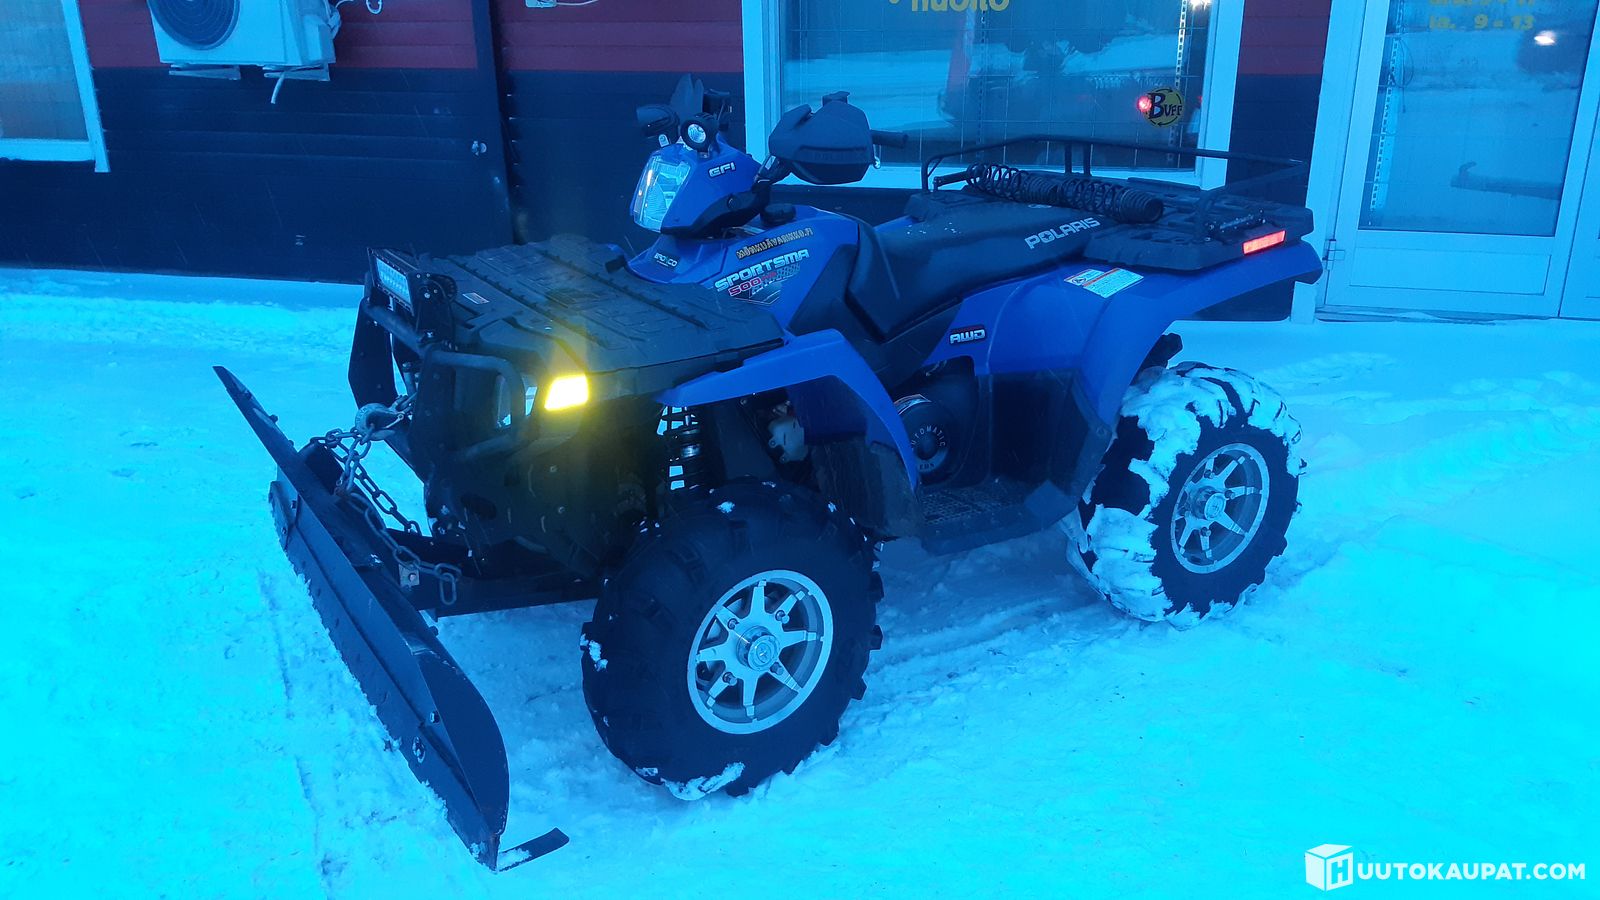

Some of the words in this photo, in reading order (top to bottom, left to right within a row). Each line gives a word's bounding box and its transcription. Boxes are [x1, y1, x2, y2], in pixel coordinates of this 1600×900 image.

[1474, 14, 1488, 29] 9
[708, 162, 736, 178] EFI
[1024, 217, 1101, 249] POLARIS
[728, 276, 762, 297] 500
[949, 329, 986, 344] AWD
[911, 425, 946, 451] UTOMATIC
